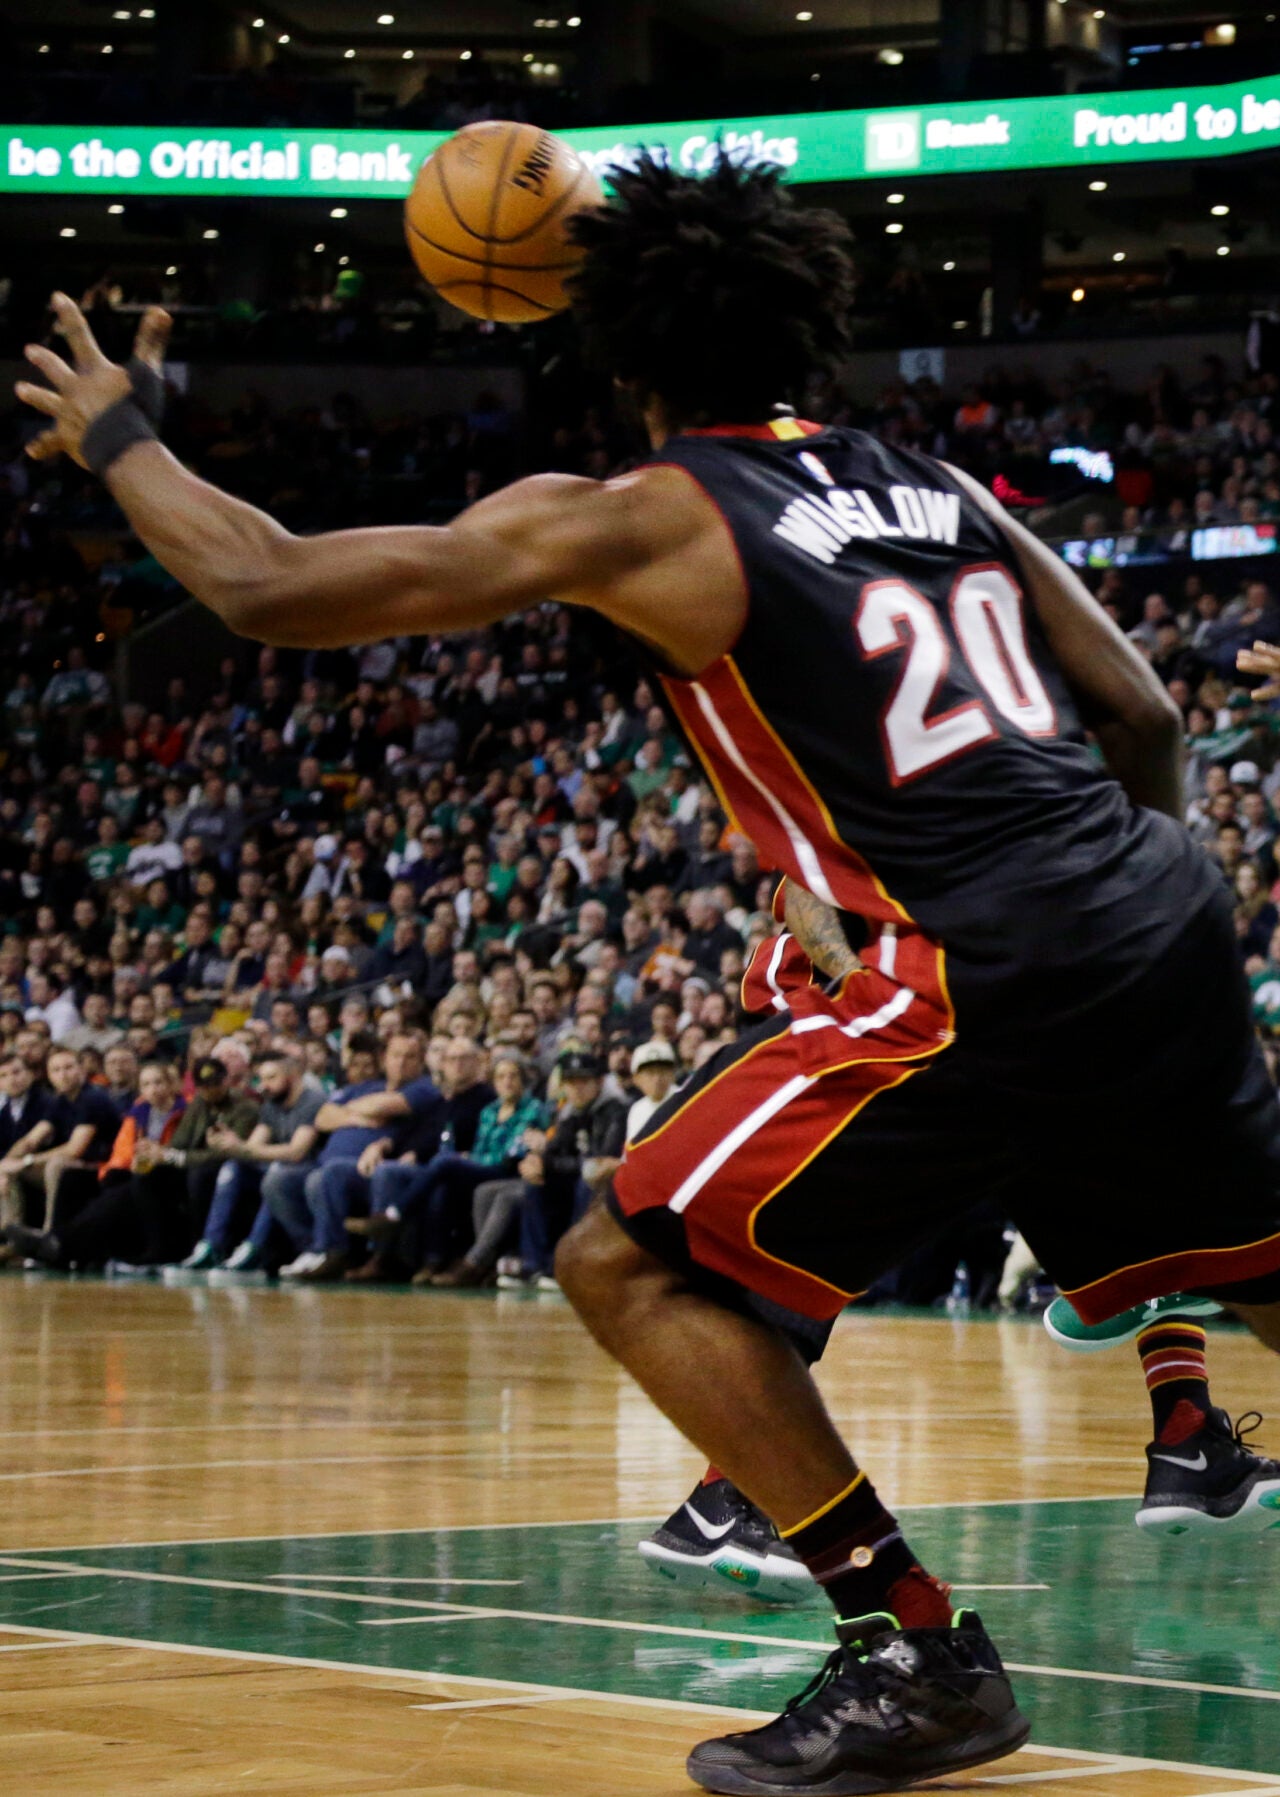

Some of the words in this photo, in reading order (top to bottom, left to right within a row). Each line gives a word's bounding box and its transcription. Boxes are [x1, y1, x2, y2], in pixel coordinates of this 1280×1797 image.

[868, 121, 918, 161] TD
[926, 114, 1010, 149] Bank
[1074, 102, 1187, 147] Proud
[1196, 105, 1236, 140] to
[7, 138, 61, 177] be
[69, 138, 141, 178] the
[149, 140, 299, 181] Official
[309, 143, 413, 182] Bank
[855, 561, 1058, 788] 20
